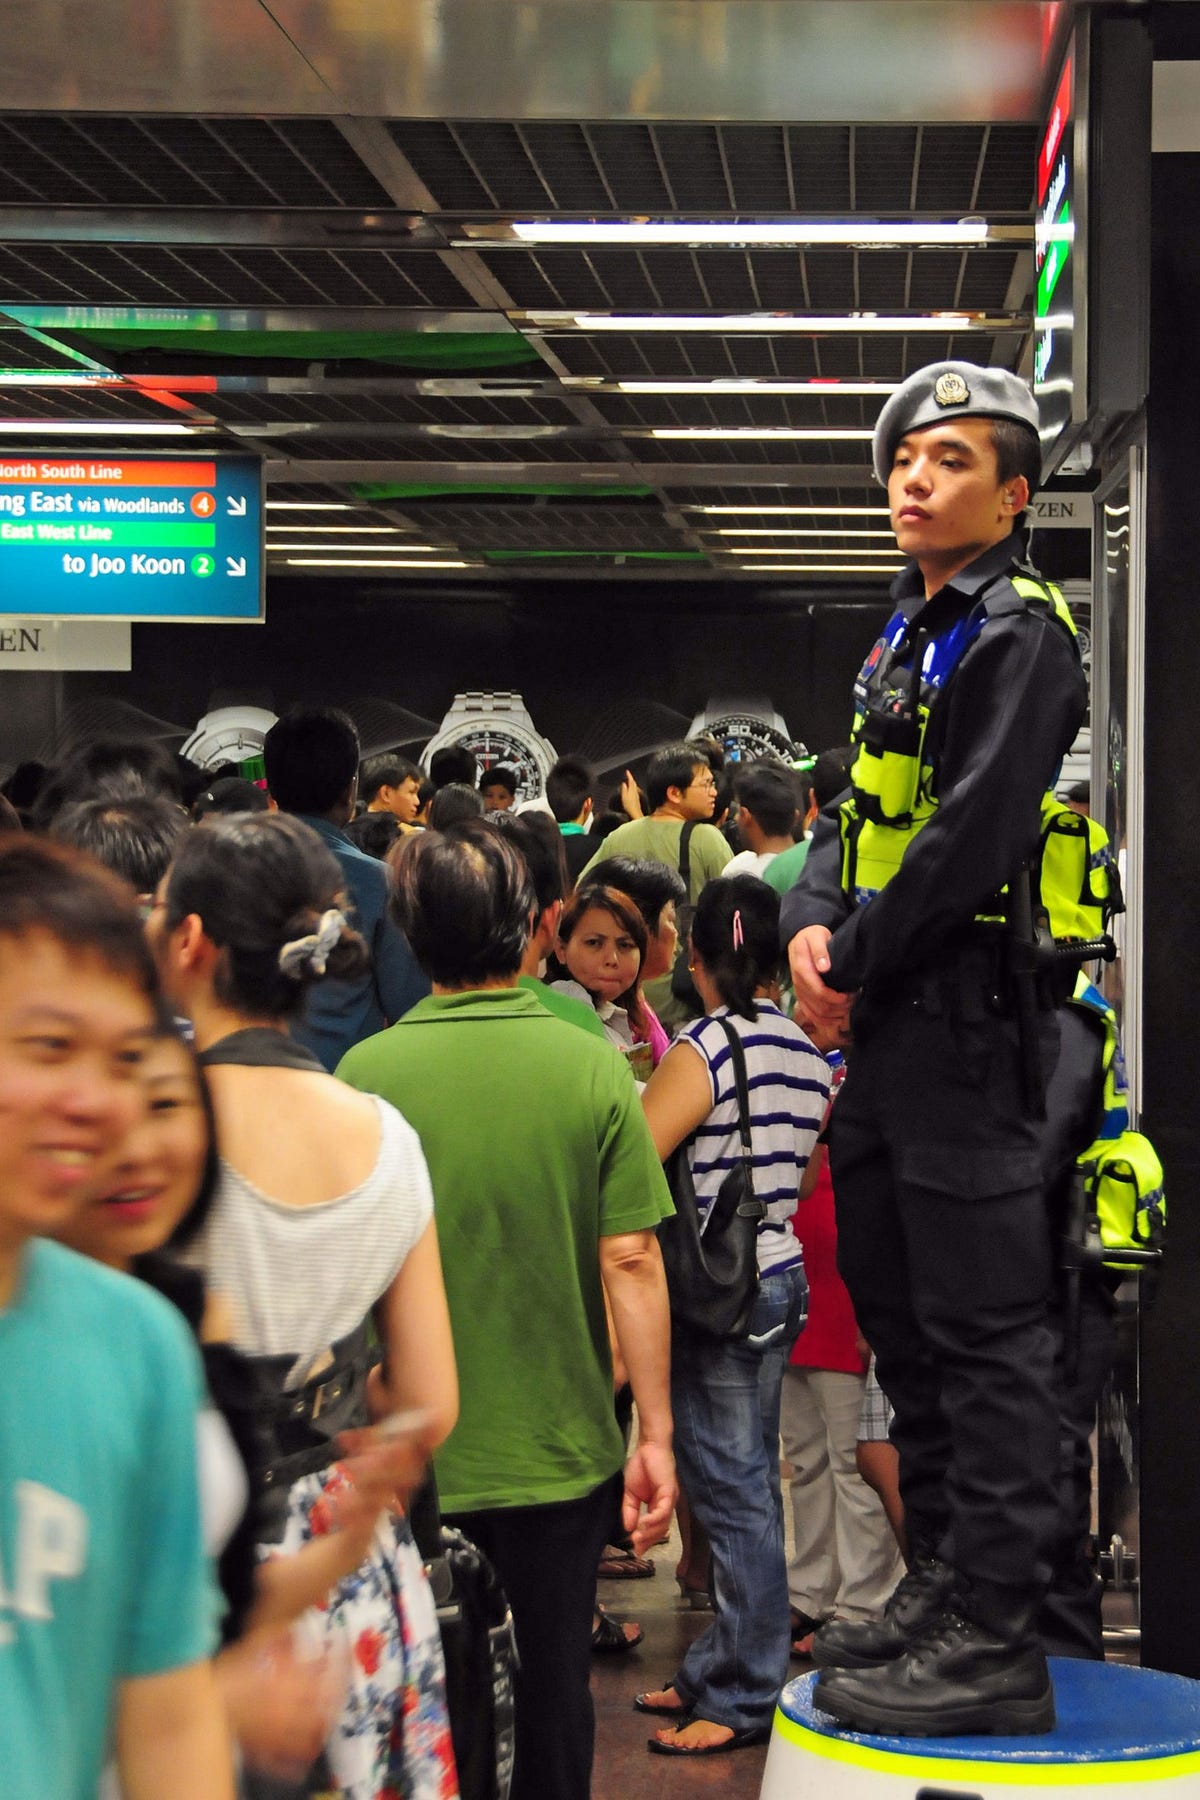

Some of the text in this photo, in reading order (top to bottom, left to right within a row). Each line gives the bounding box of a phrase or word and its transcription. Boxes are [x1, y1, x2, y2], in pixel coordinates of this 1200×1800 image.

[41, 463, 86, 479] South
[90, 464, 123, 479] Line
[30, 491, 74, 513] East
[78, 496, 101, 513] via
[103, 497, 186, 514] Woodlands
[197, 496, 209, 513] 4
[1035, 502, 1075, 518] ZEN
[1, 523, 113, 540] East West Line
[62, 552, 209, 577] to Joo Koon 2
